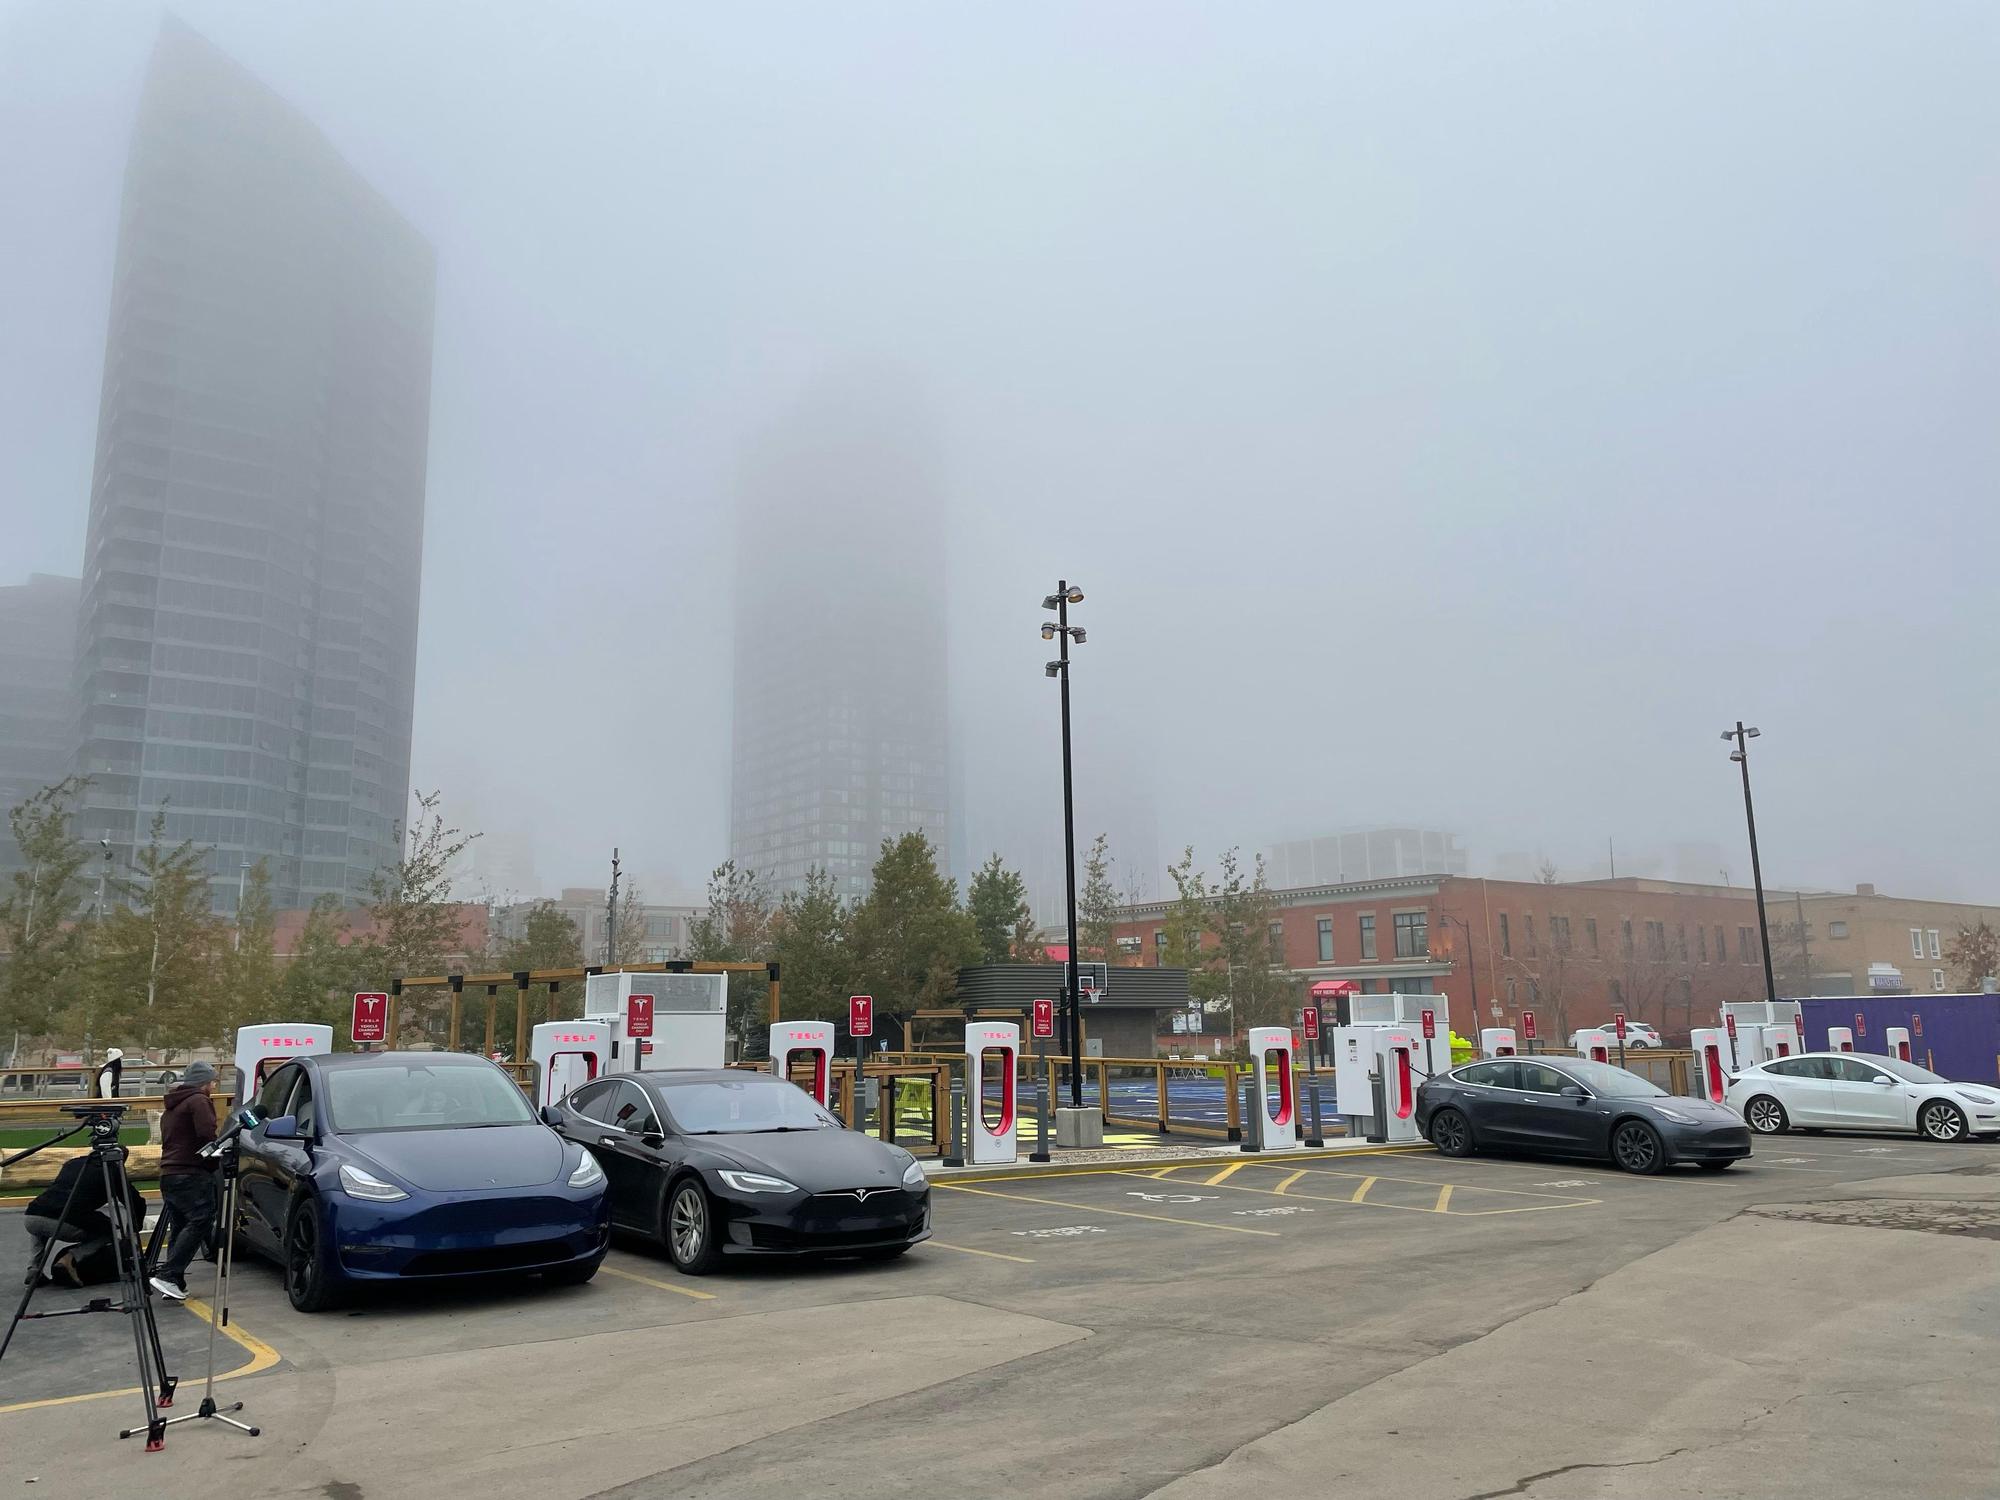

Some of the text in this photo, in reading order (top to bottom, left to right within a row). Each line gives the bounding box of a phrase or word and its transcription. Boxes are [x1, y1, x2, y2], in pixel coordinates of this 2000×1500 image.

[790, 1032, 824, 1040] TESLA
[983, 1032, 1013, 1040] TESLA
[261, 1038, 315, 1047] TESLA
